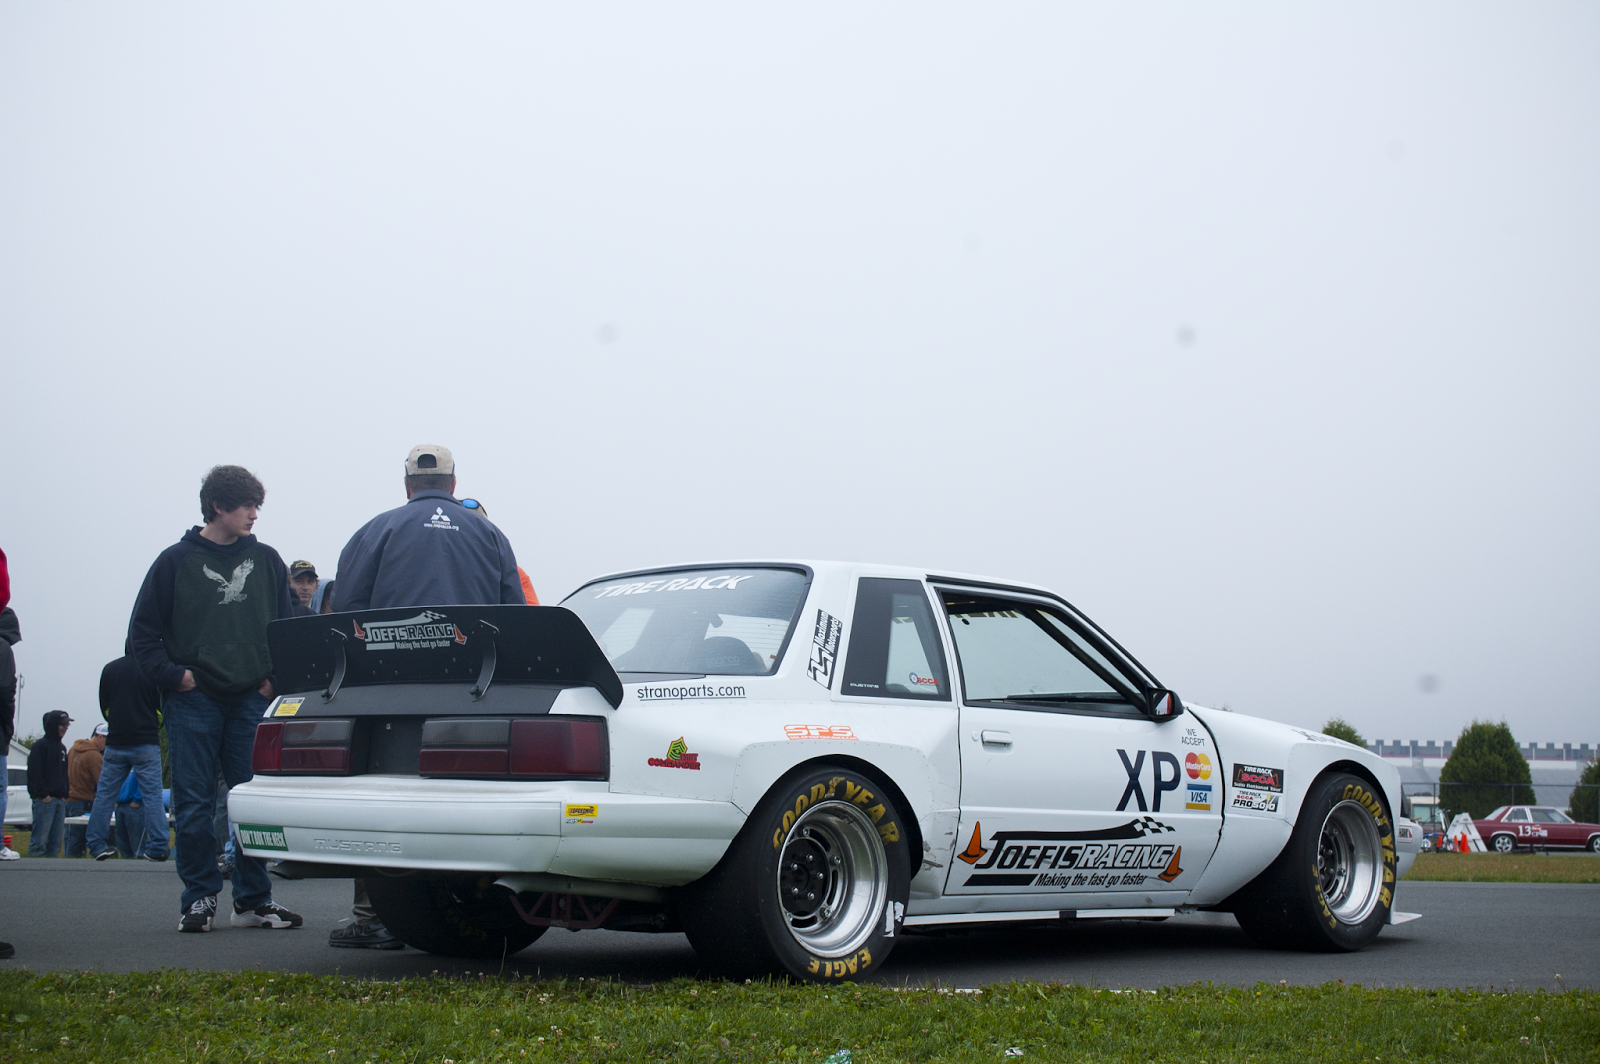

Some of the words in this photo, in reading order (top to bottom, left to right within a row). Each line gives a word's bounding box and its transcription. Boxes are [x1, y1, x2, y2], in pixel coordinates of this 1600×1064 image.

[593, 580, 667, 599] TIRE
[655, 575, 754, 592] RACK
[813, 610, 828, 647] Maximum
[825, 617, 841, 654] Motorsports
[396, 641, 413, 650] Making
[420, 640, 430, 648] fast
[437, 640, 450, 648] faster
[916, 677, 940, 685] SCCA
[637, 684, 746, 701] stranoparts.com
[783, 724, 855, 738] SPS
[1185, 728, 1197, 737] WE
[1181, 735, 1205, 747] ACCEPT
[647, 757, 701, 770] COMMANDER
[680, 753, 698, 762] DIRT
[1186, 761, 1212, 771] MasterCard
[1243, 765, 1257, 773] TIRE
[1257, 767, 1273, 776] RACK
[1115, 748, 1181, 812] XP
[1241, 773, 1275, 786] SCCA
[1190, 791, 1208, 803] VISA
[1517, 825, 1532, 837] 13
[314, 838, 402, 854] MUSTANG
[1034, 873, 1074, 889] Making
[1074, 873, 1086, 886] the
[1086, 873, 1107, 886] fast
[1106, 876, 1120, 889] go
[1119, 873, 1148, 886] faster
[807, 947, 872, 978] EAGLE
